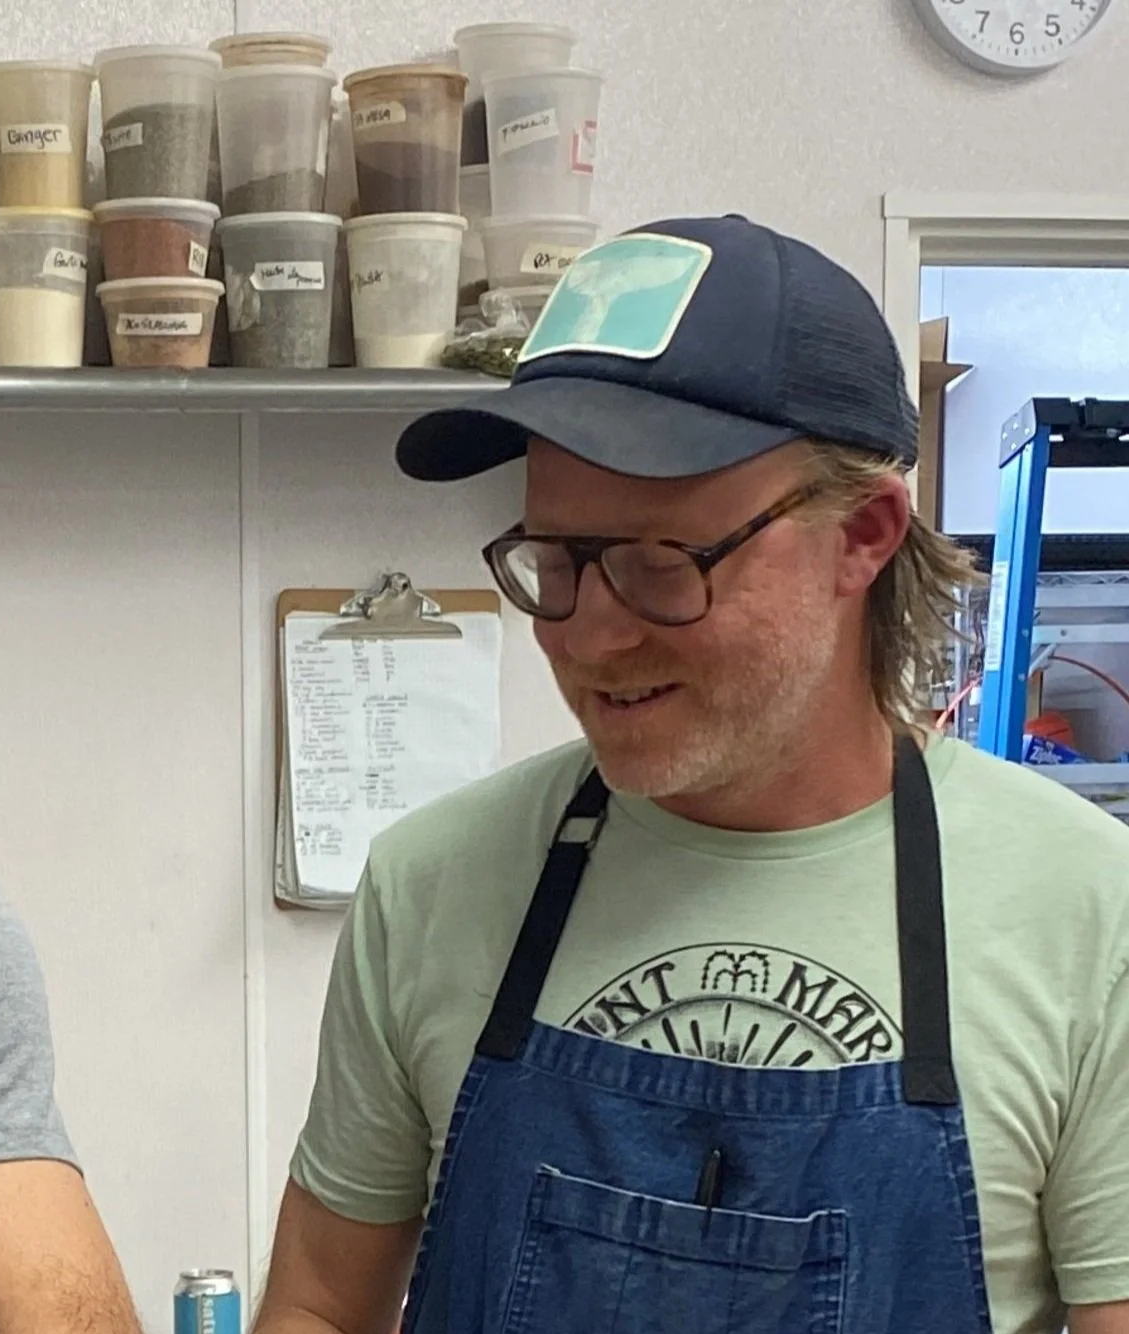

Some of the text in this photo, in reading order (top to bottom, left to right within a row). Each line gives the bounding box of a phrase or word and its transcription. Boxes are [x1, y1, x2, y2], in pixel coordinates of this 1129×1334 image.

[975, 10, 991, 34] 7
[1009, 22, 1025, 45] 6
[1044, 14, 1061, 37] 5
[6, 129, 63, 150] Ginger
